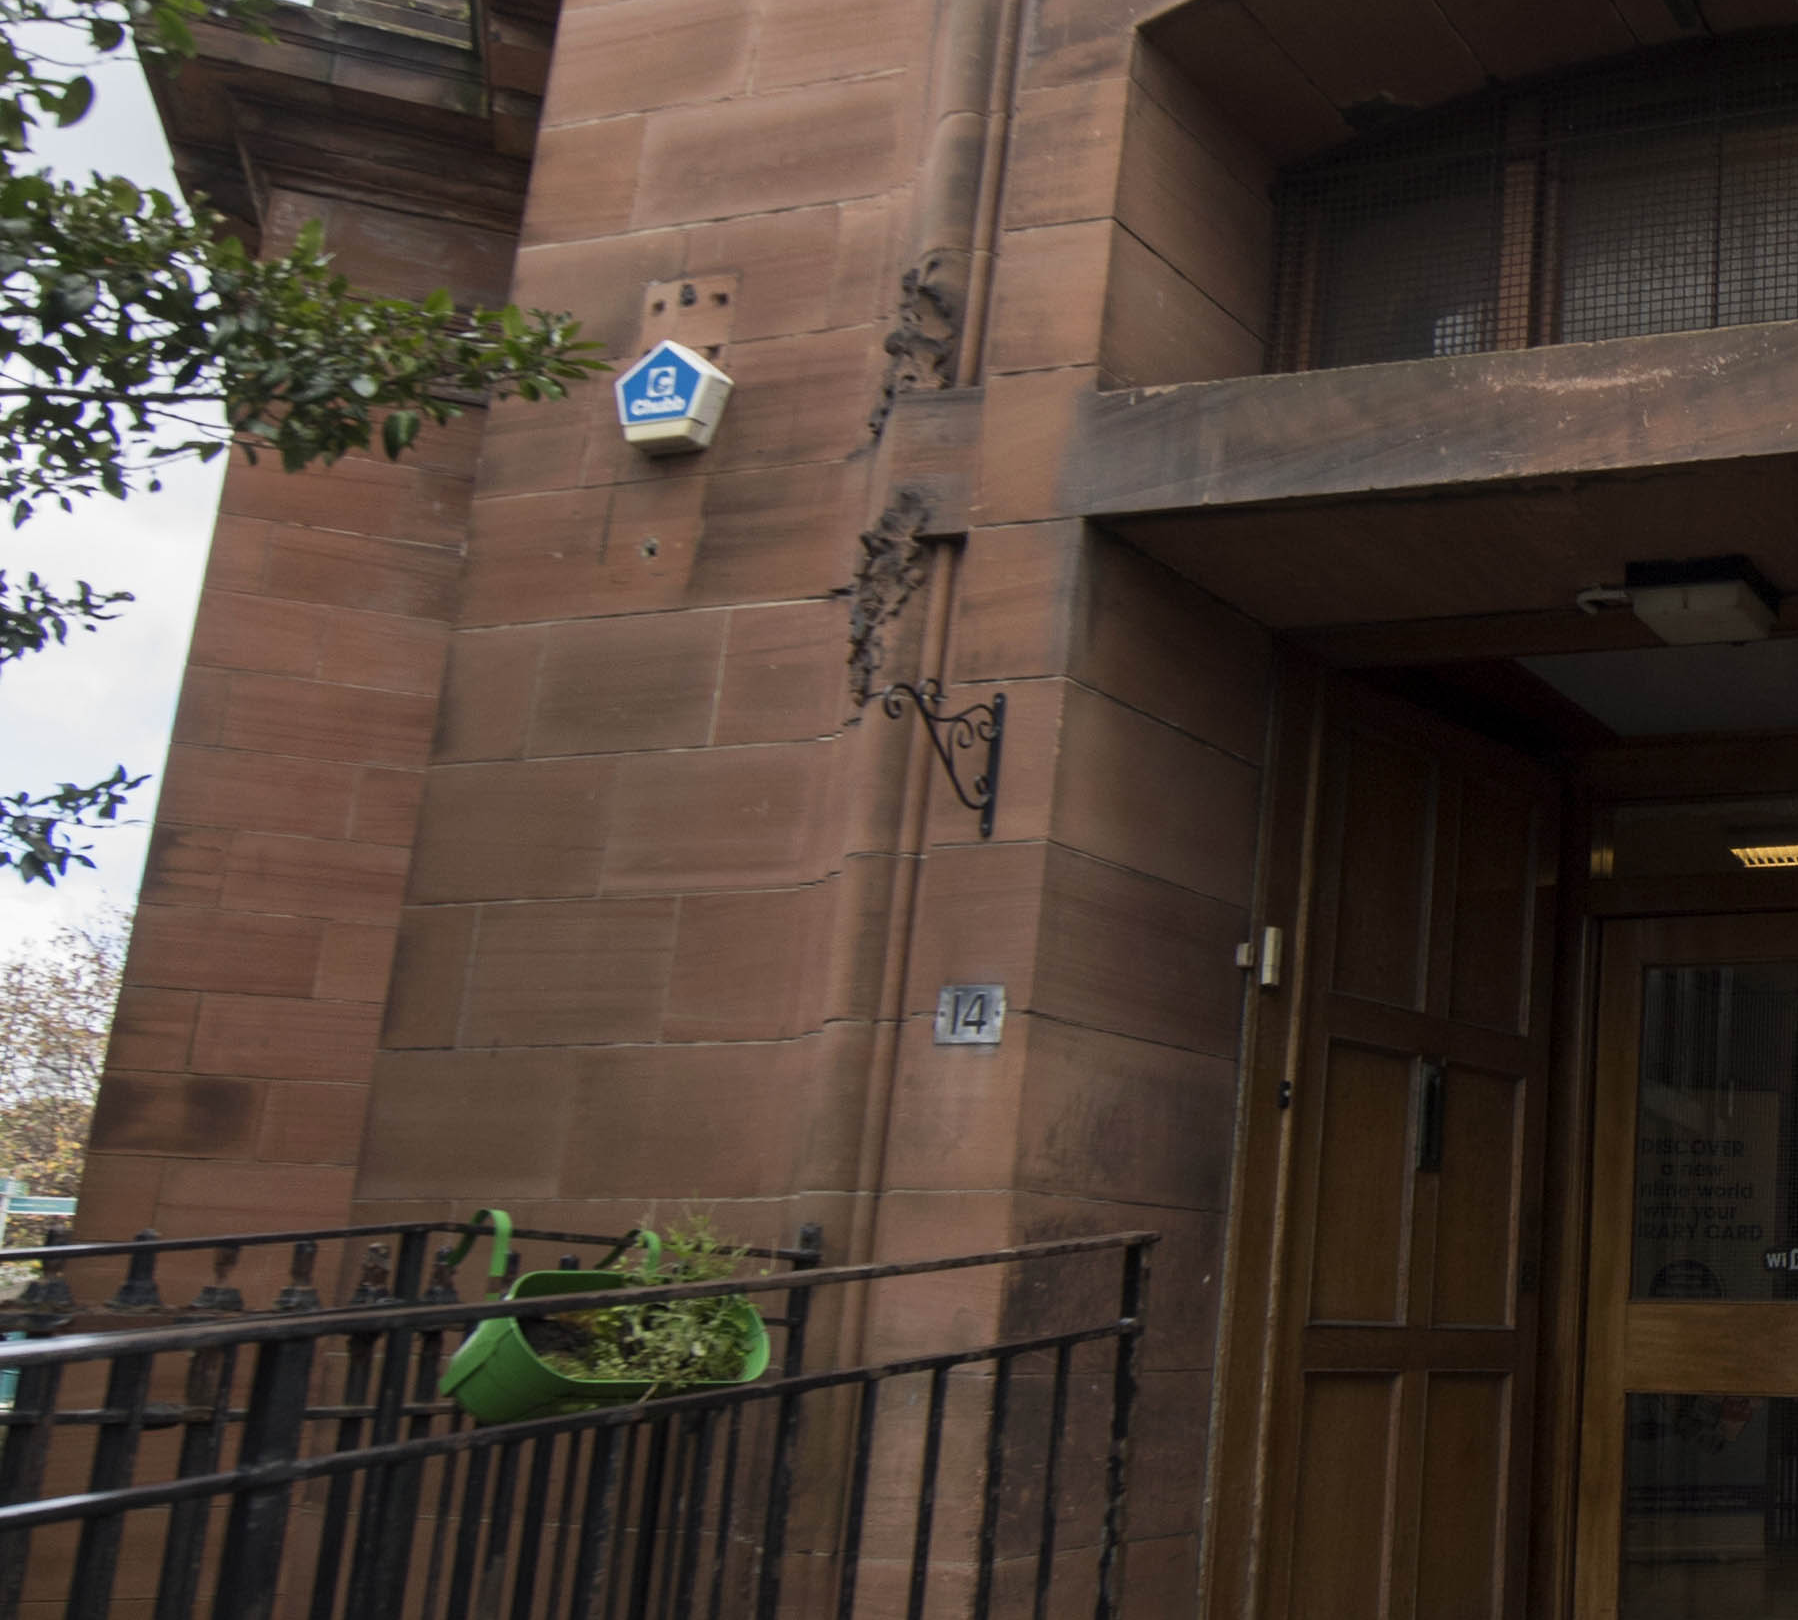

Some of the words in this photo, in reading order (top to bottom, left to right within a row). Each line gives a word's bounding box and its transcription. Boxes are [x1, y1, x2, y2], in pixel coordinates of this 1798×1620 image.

[630, 393, 687, 417] Chubb
[951, 992, 988, 1035] 14
[1640, 1138, 1745, 1157] DISCOVER
[1681, 1163, 1723, 1177] new
[1639, 1178, 1690, 1197] nline
[1697, 1182, 1754, 1199] world
[1643, 1201, 1686, 1220] with
[1690, 1204, 1737, 1224] your
[1703, 1224, 1764, 1242] CARD
